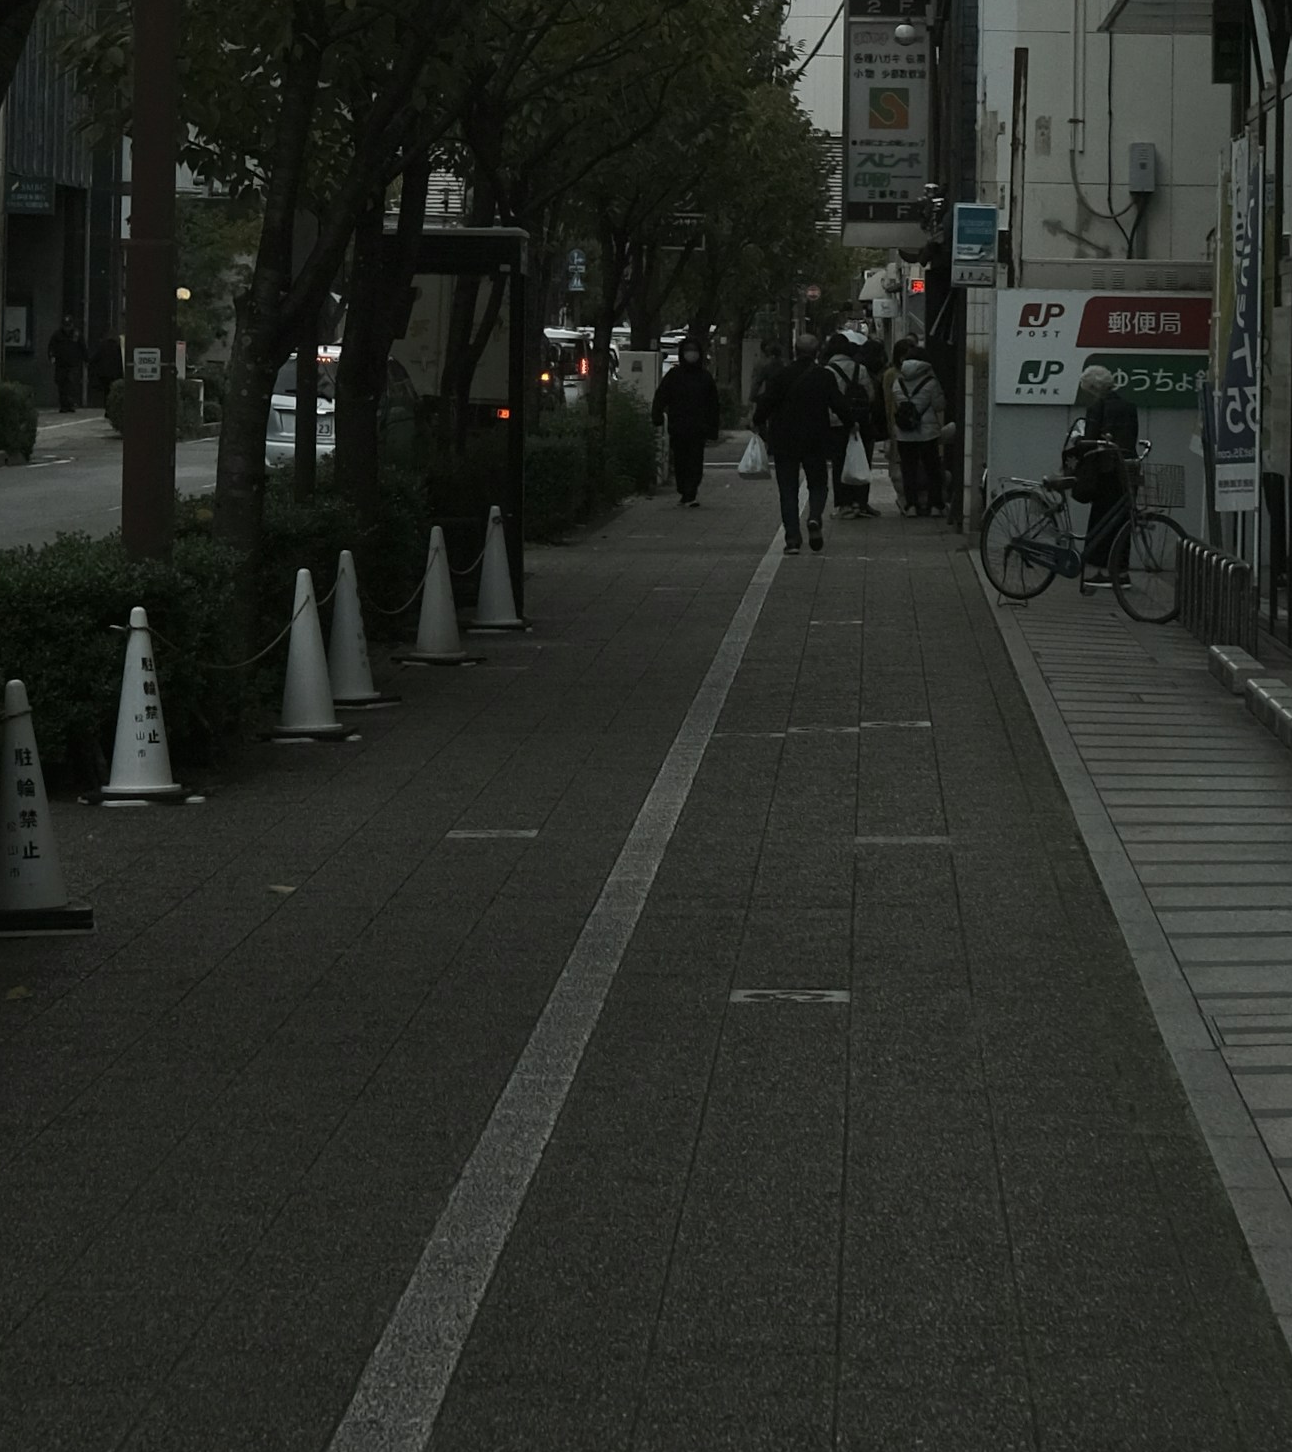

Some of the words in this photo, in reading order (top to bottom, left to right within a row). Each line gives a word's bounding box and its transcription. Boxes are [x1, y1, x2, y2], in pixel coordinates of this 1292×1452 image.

[1019, 302, 1065, 327] JP
[1107, 310, 1182, 335] 郵便局
[1016, 330, 1061, 338] POST
[1018, 360, 1064, 385] JP
[1015, 387, 1060, 395] BANK
[12, 747, 40, 860] 駐輪禁止
[5, 820, 22, 880] 松山市
